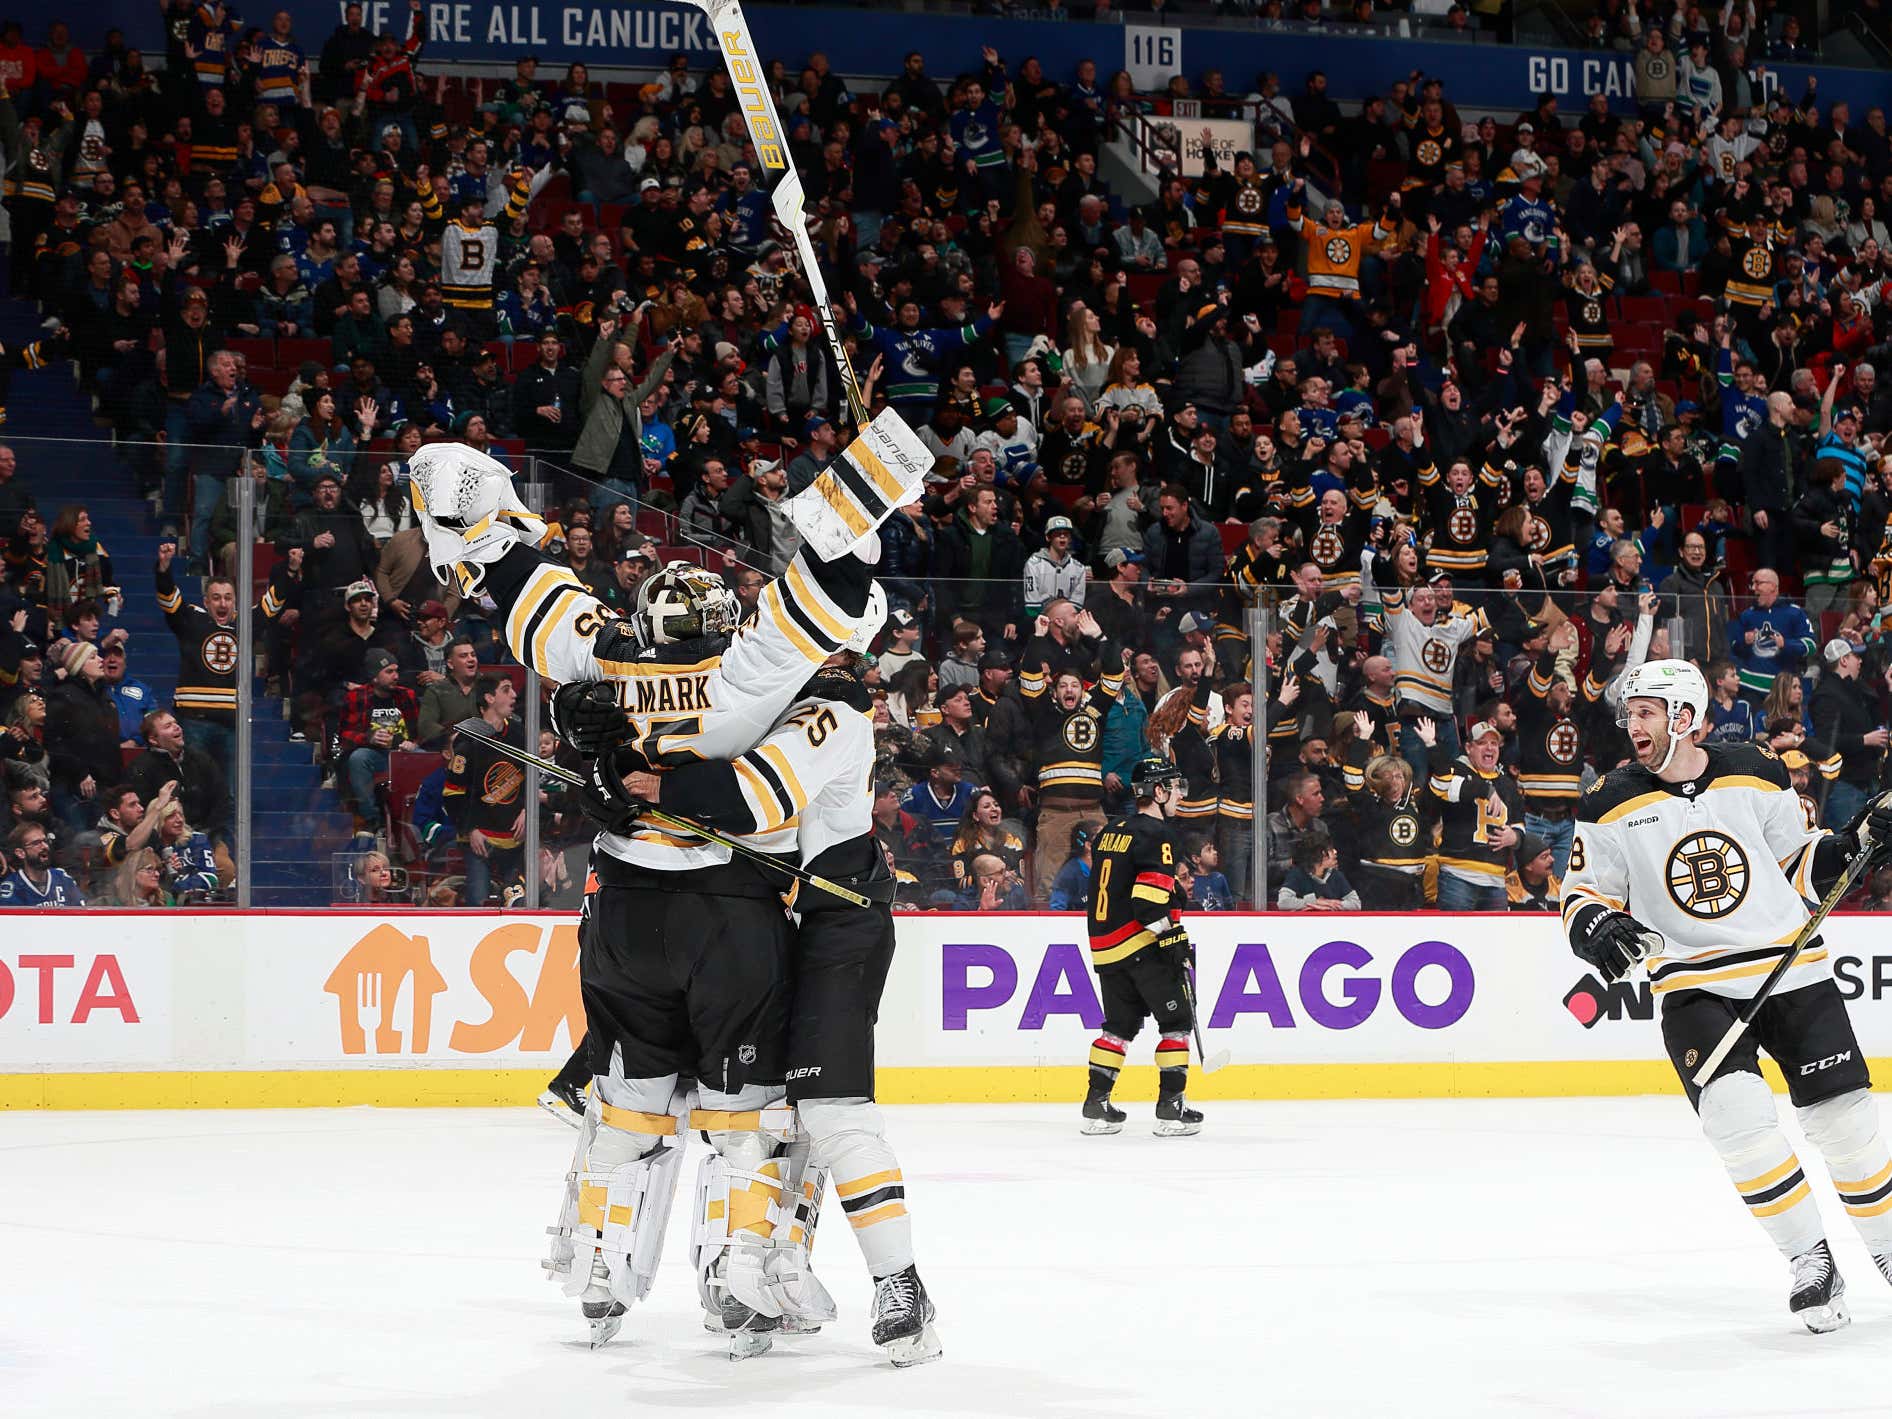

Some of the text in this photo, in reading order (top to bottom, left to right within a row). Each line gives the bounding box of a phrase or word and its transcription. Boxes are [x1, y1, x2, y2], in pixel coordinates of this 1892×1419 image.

[487, 6, 547, 44] ALL
[1134, 36, 1173, 66] 116
[1529, 56, 1568, 94] GO
[722, 30, 785, 169] BAUER
[1177, 102, 1197, 117] EXIT
[1186, 138, 1219, 149] HOE
[1186, 148, 1238, 161] HOKEY
[460, 239, 485, 271] B
[613, 675, 713, 713] LMARK
[1160, 842, 1174, 866] 8
[1097, 857, 1114, 925] 8
[1684, 848, 1731, 904] B
[0, 954, 140, 1024] TA
[942, 940, 1475, 1031] PAAGO
[1800, 1050, 1851, 1077] CCM
